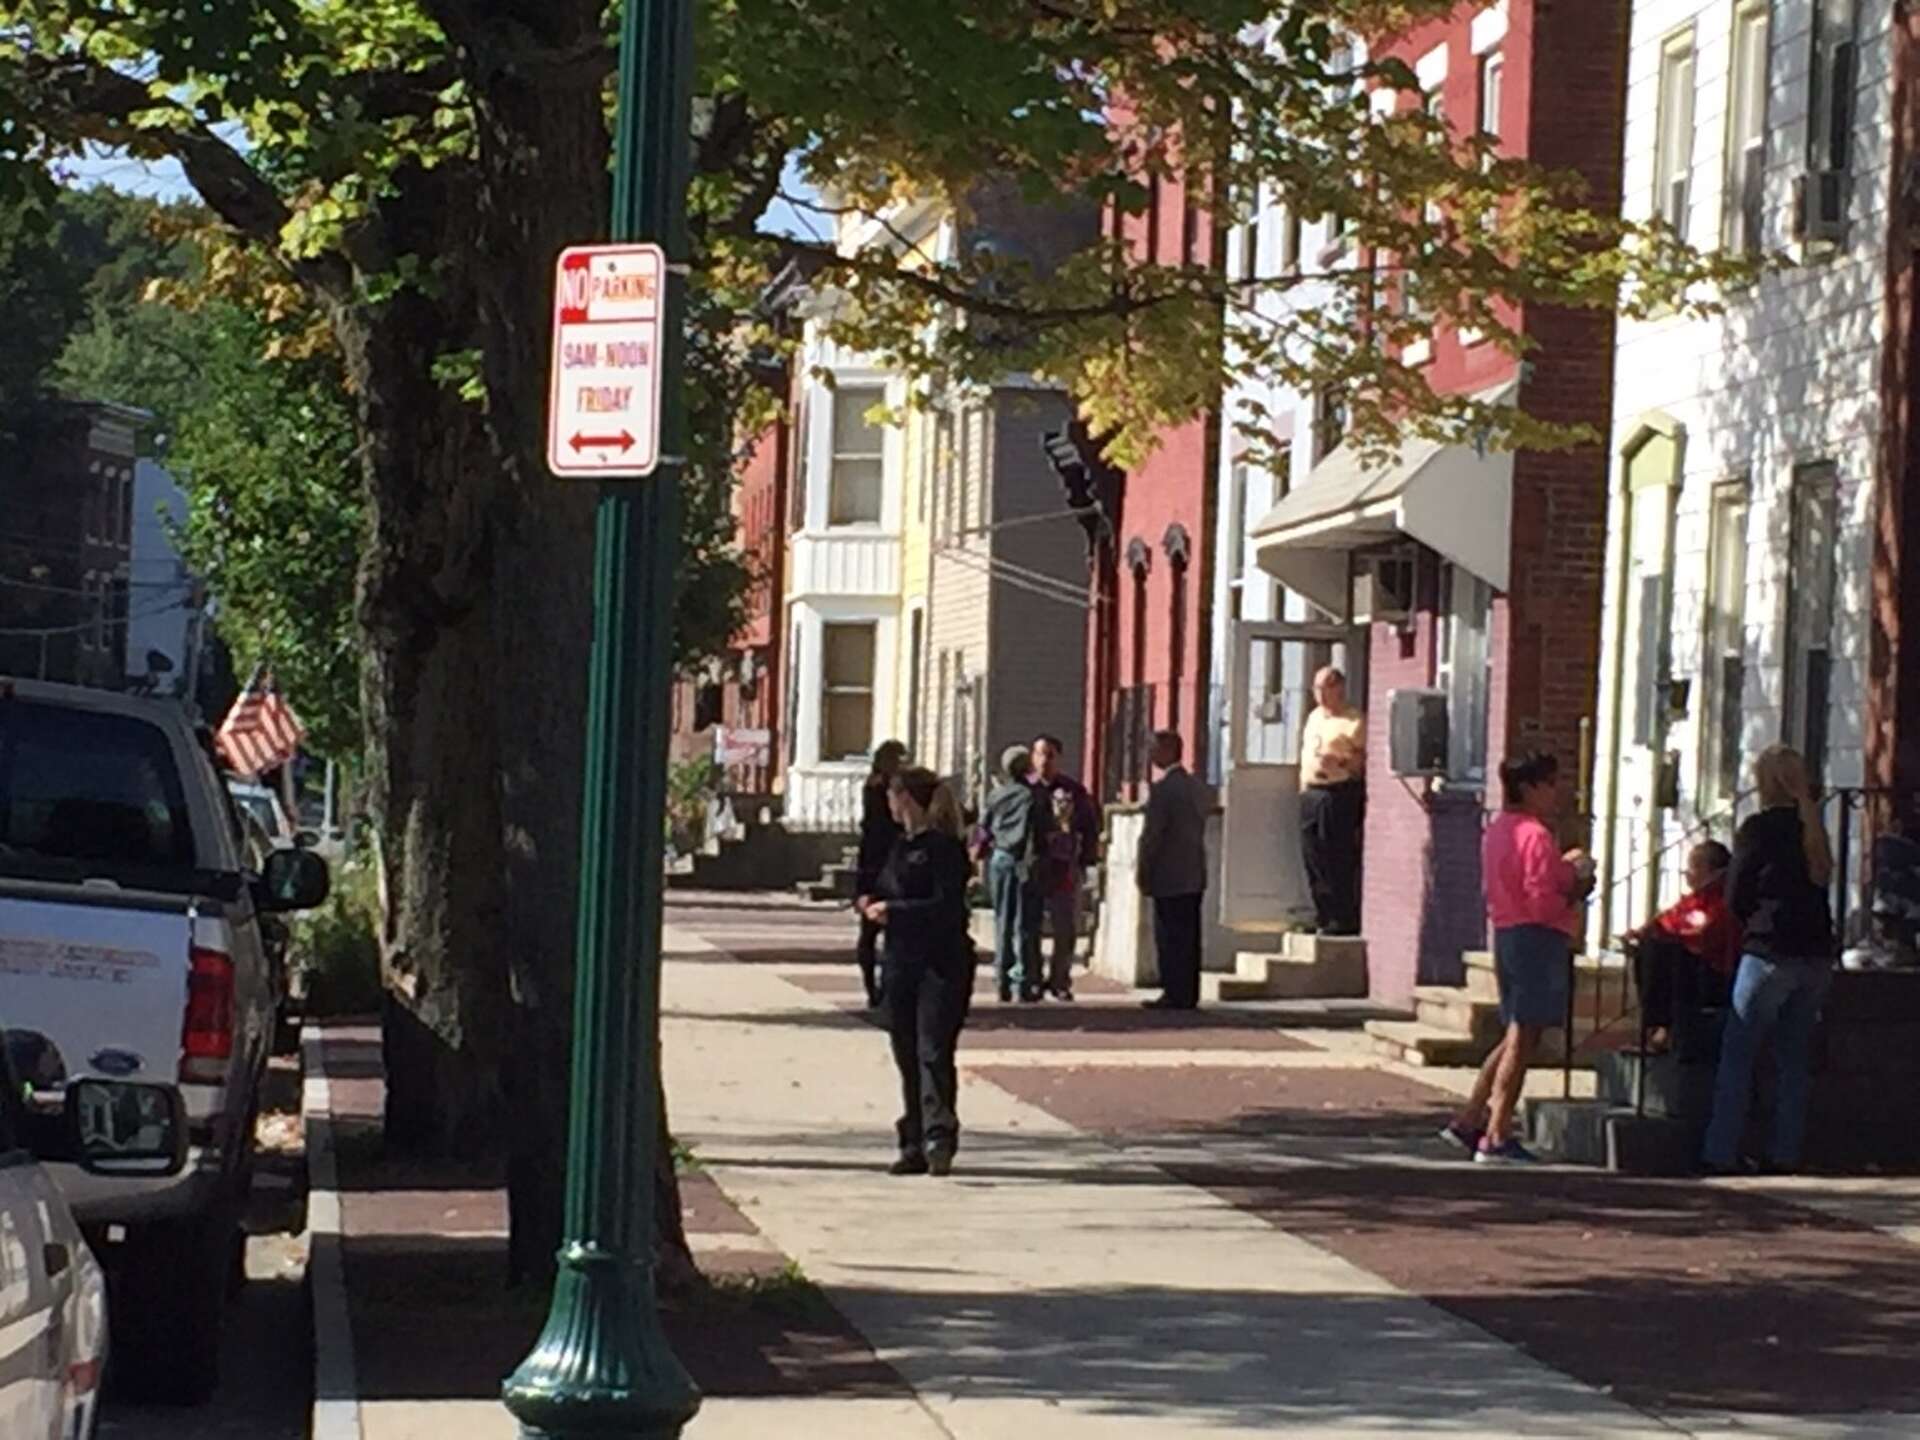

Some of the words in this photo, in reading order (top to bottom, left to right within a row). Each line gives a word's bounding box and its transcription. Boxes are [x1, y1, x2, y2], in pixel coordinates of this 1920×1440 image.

[561, 268, 589, 310] NO
[592, 275, 655, 299] PARKING
[577, 386, 633, 413] FRIDAY
